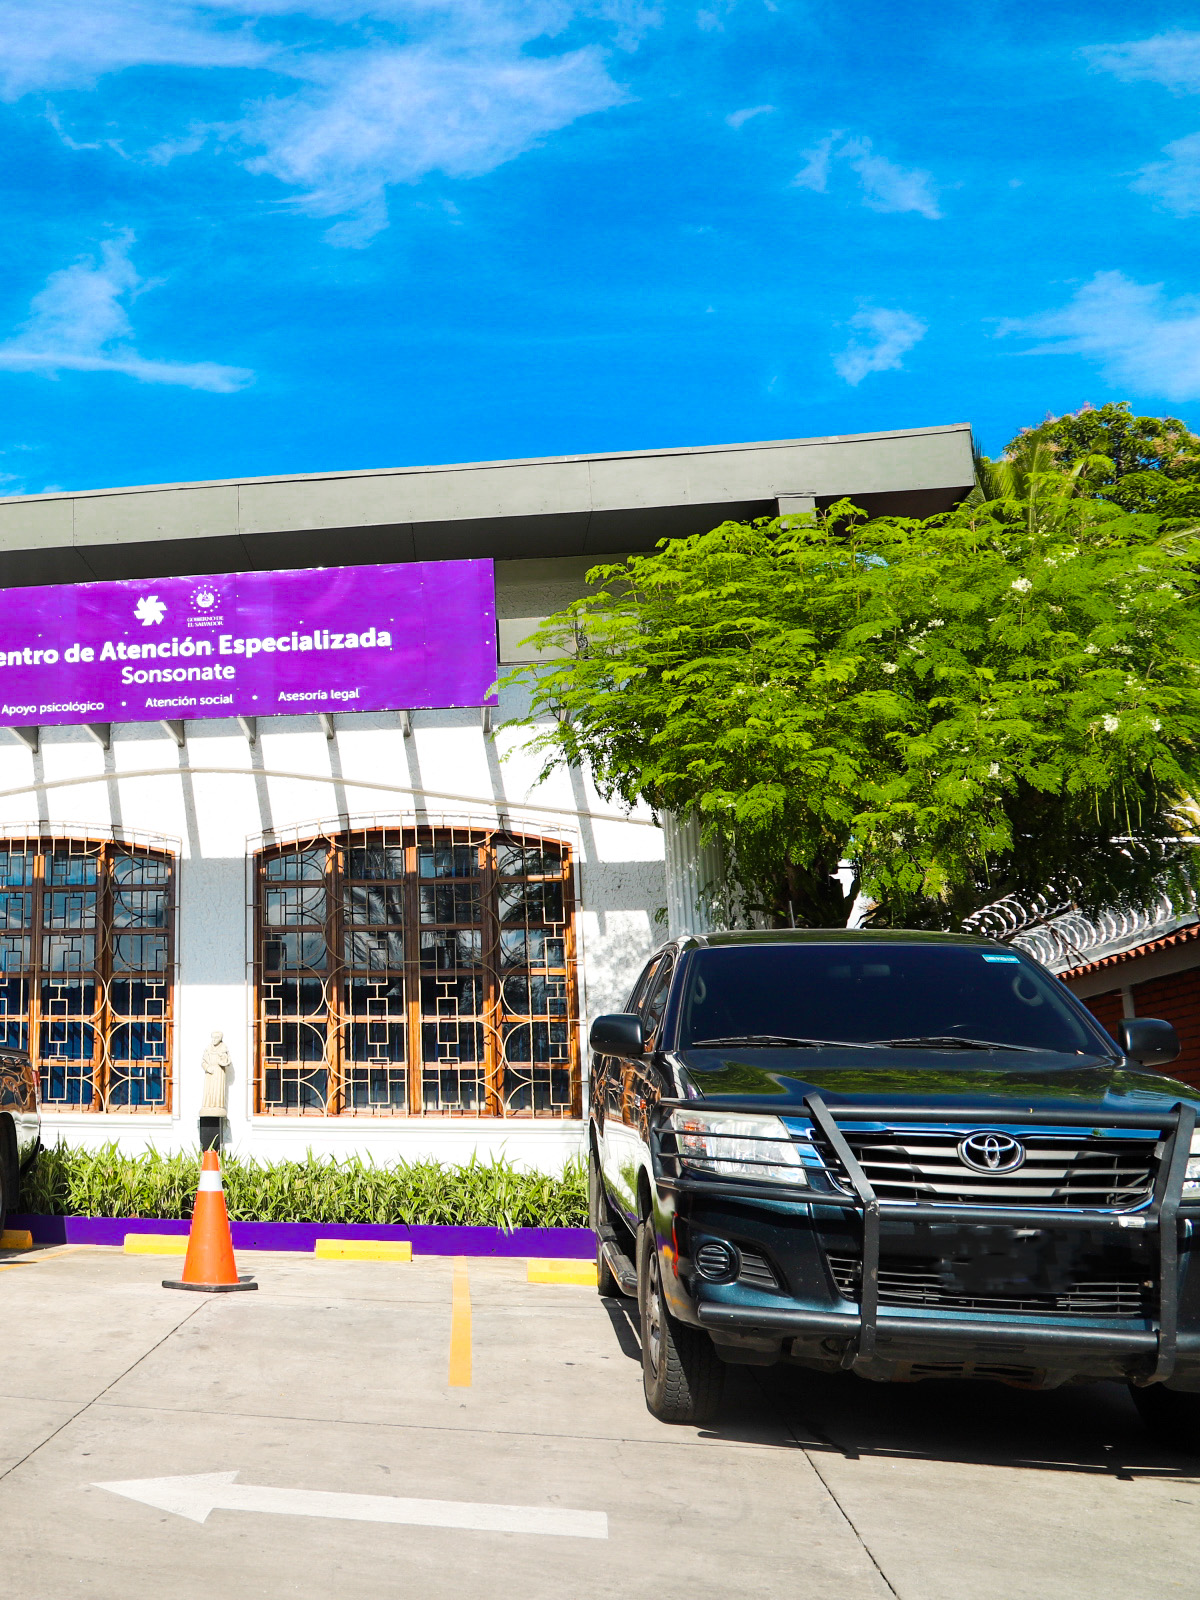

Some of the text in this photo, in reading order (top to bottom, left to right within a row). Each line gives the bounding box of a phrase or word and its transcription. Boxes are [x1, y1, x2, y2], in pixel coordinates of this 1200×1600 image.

[64, 643, 95, 663] de
[100, 636, 212, 661] Atención
[219, 627, 392, 658] Especializada
[121, 663, 236, 685] Sonsonate
[1, 687, 360, 717] Apoyo psicológico Atención social Asesoría legal
